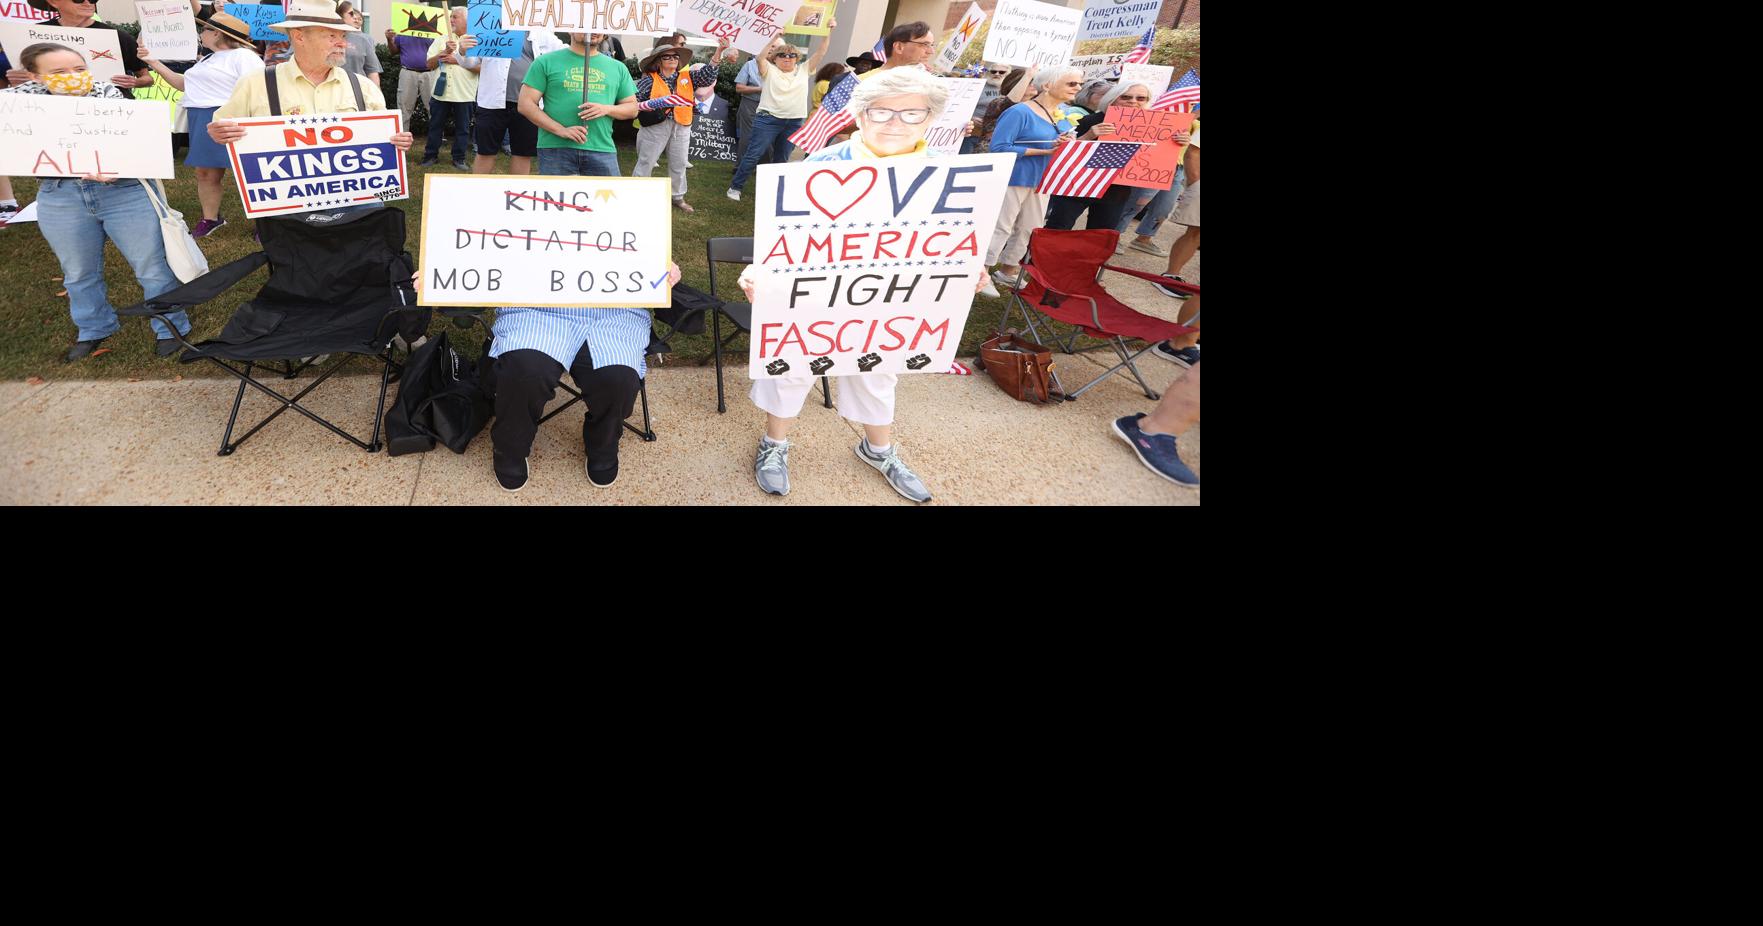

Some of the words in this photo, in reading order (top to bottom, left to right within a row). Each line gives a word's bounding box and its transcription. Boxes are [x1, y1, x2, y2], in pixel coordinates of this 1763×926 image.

[503, 0, 669, 32] WEALTHCARE
[1085, 1, 1157, 18] Congressman
[750, 19, 781, 38] FIRST
[1086, 16, 1113, 31] Trent
[1116, 15, 1144, 29] Kelly
[994, 37, 1018, 59] NO
[75, 101, 134, 120] Liberty
[3, 123, 33, 136] And
[70, 124, 129, 136] Justice
[283, 126, 353, 147] NO
[33, 150, 119, 174] ALL
[257, 148, 384, 180] KINGS
[248, 187, 278, 202] IN
[287, 174, 400, 199] AMERICA
[373, 187, 401, 198] SINCE
[379, 193, 401, 202] 1776
[504, 190, 592, 212] KING
[456, 229, 637, 251] DICTATOR
[762, 230, 978, 265] AMERICA
[433, 268, 502, 290] MOB
[550, 270, 644, 293] BOSS
[789, 274, 969, 309] FIGHT
[759, 316, 950, 359] FASCISM
